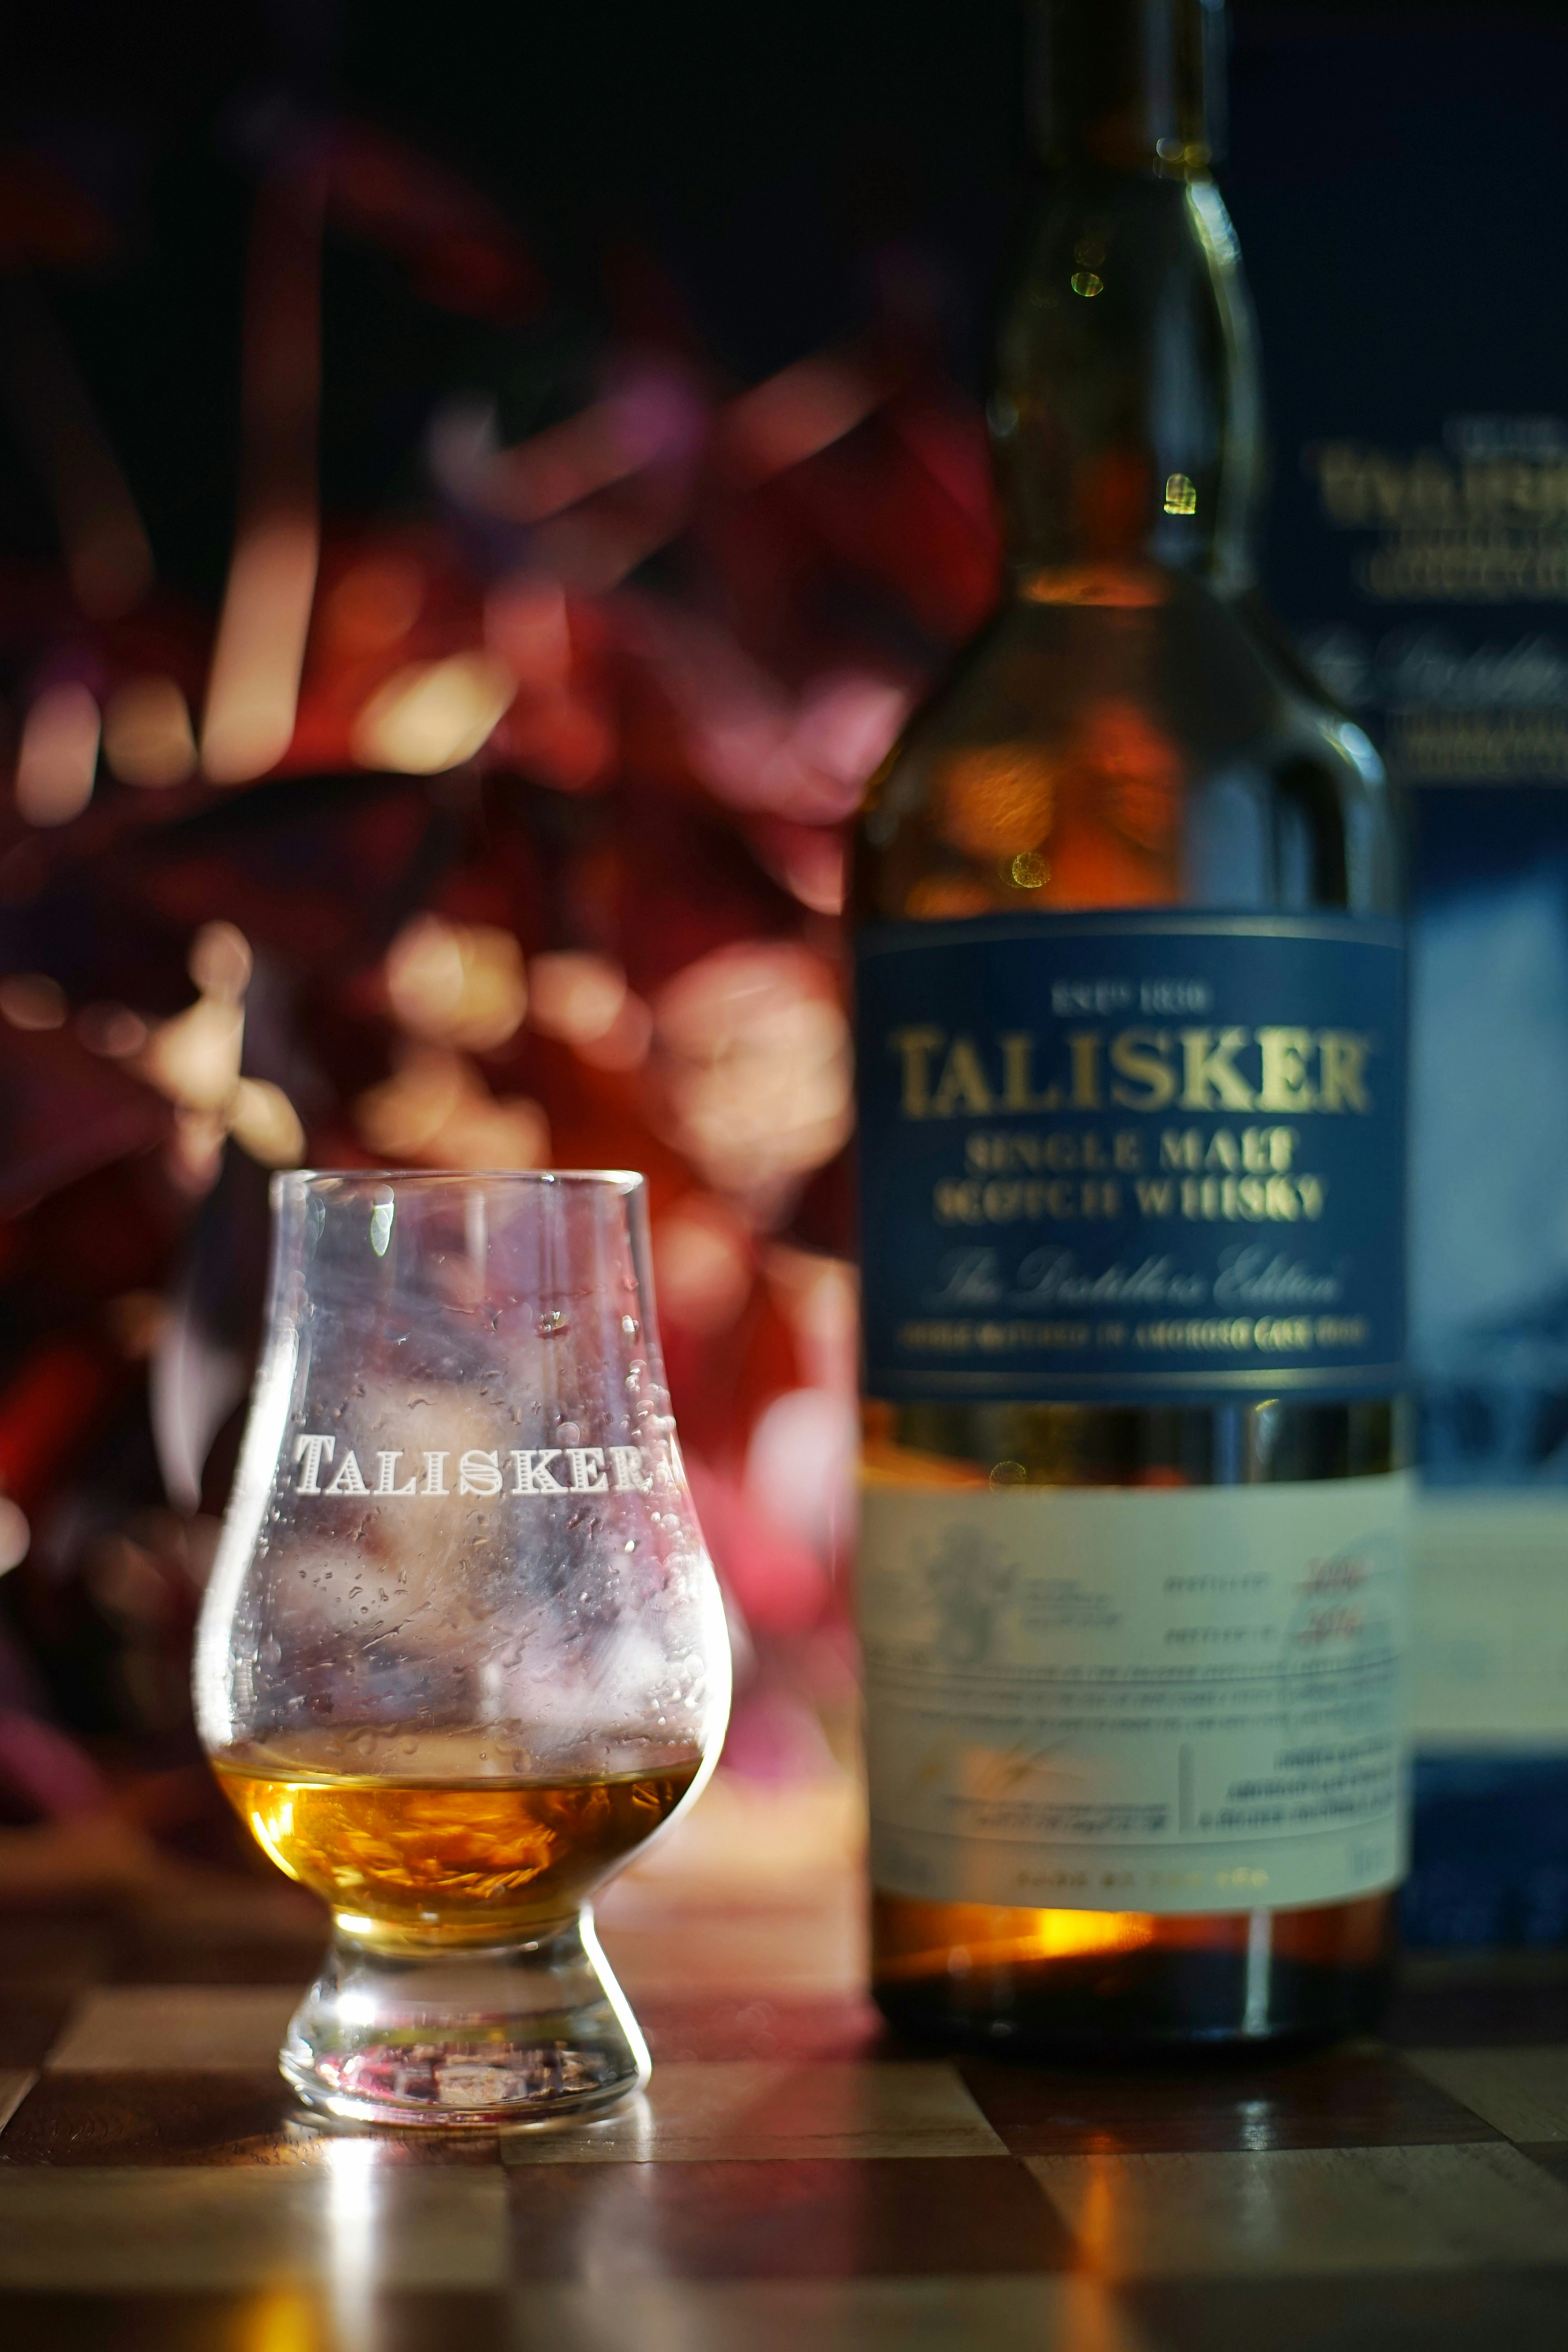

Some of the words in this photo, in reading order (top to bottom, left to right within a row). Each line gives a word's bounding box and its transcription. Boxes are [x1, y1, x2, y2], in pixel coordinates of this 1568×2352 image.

[889, 1024, 1371, 1119] TALISKER
[965, 1129, 1142, 1175] SINGLE
[1160, 1126, 1298, 1174] MALT
[933, 1175, 1122, 1225] SCOTCH
[1134, 1173, 1327, 1221] WHISKY
[293, 1433, 648, 1496] TALISKER
